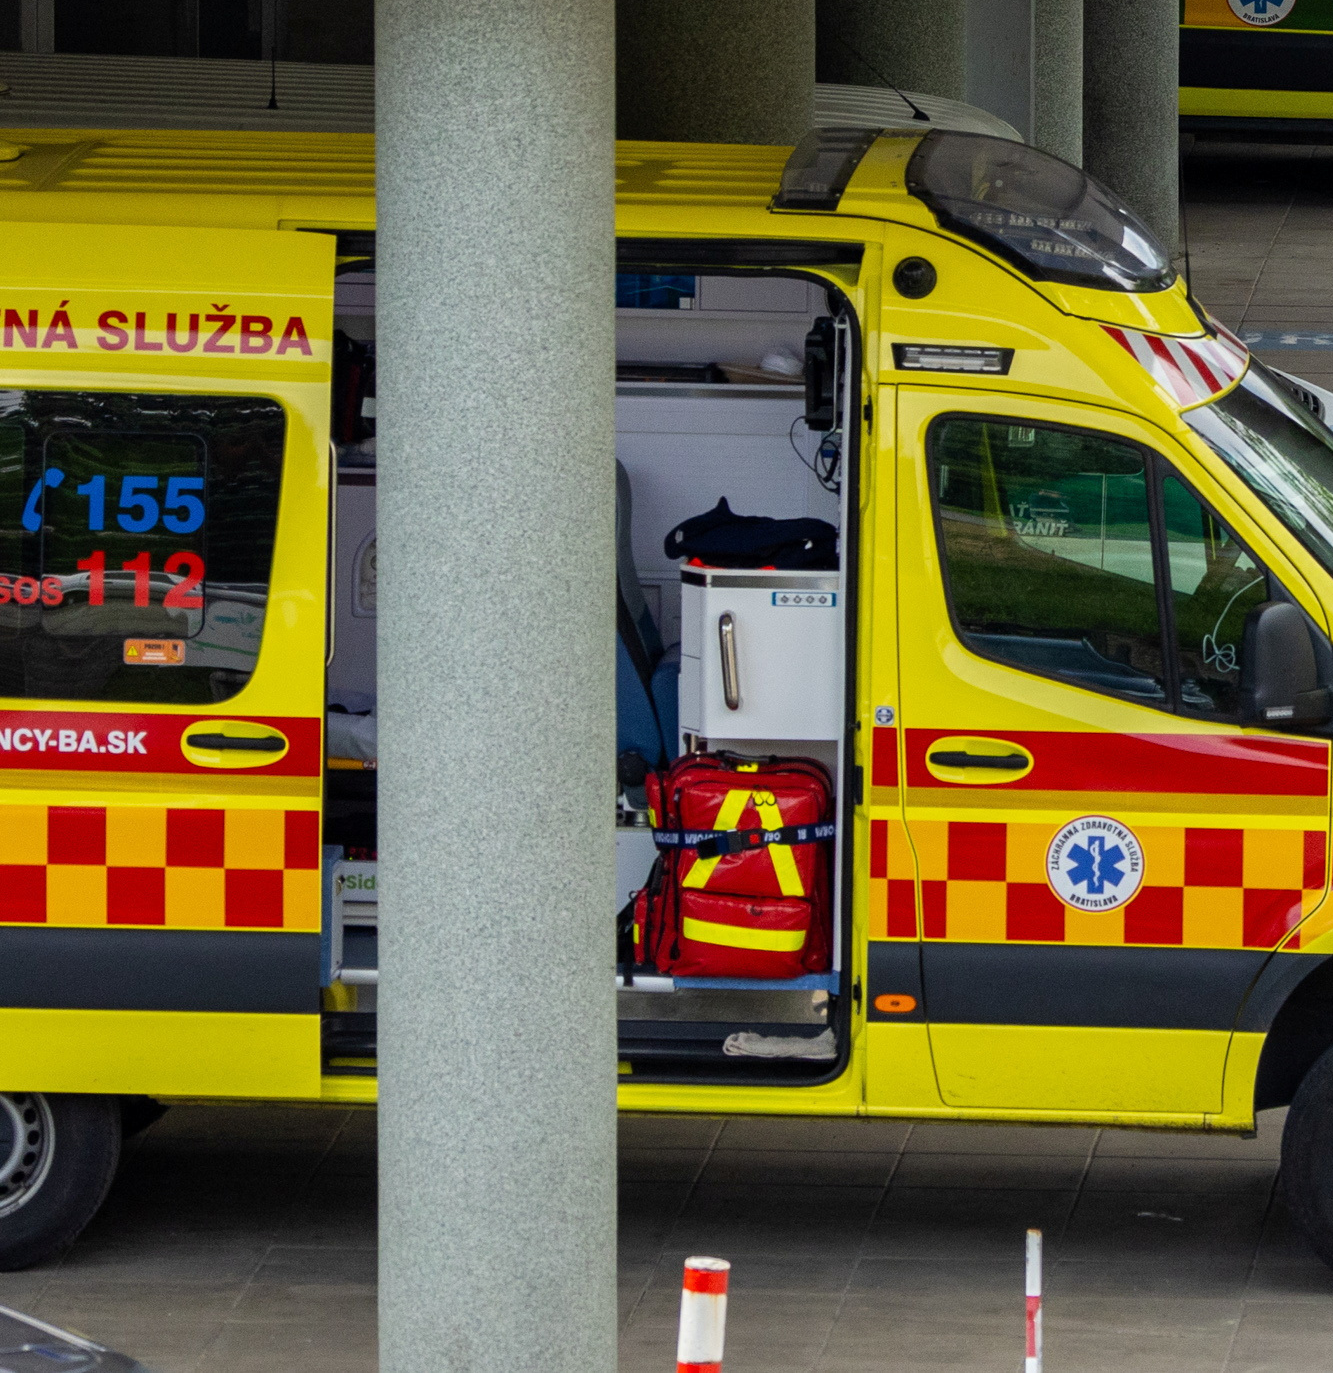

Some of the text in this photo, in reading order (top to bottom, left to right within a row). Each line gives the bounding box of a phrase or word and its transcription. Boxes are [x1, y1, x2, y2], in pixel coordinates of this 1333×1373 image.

[1242, 12, 1280, 23] BRATISLAVA
[0, 300, 313, 356] NÁ SLUŽBA
[77, 475, 206, 534] 155
[0, 550, 206, 608] SOS 112
[1051, 821, 1141, 873] ZÁCHRANNÁ ZDRAVOTNÁ SLUŽBA
[1069, 893, 1118, 908] BRATISLAVA
